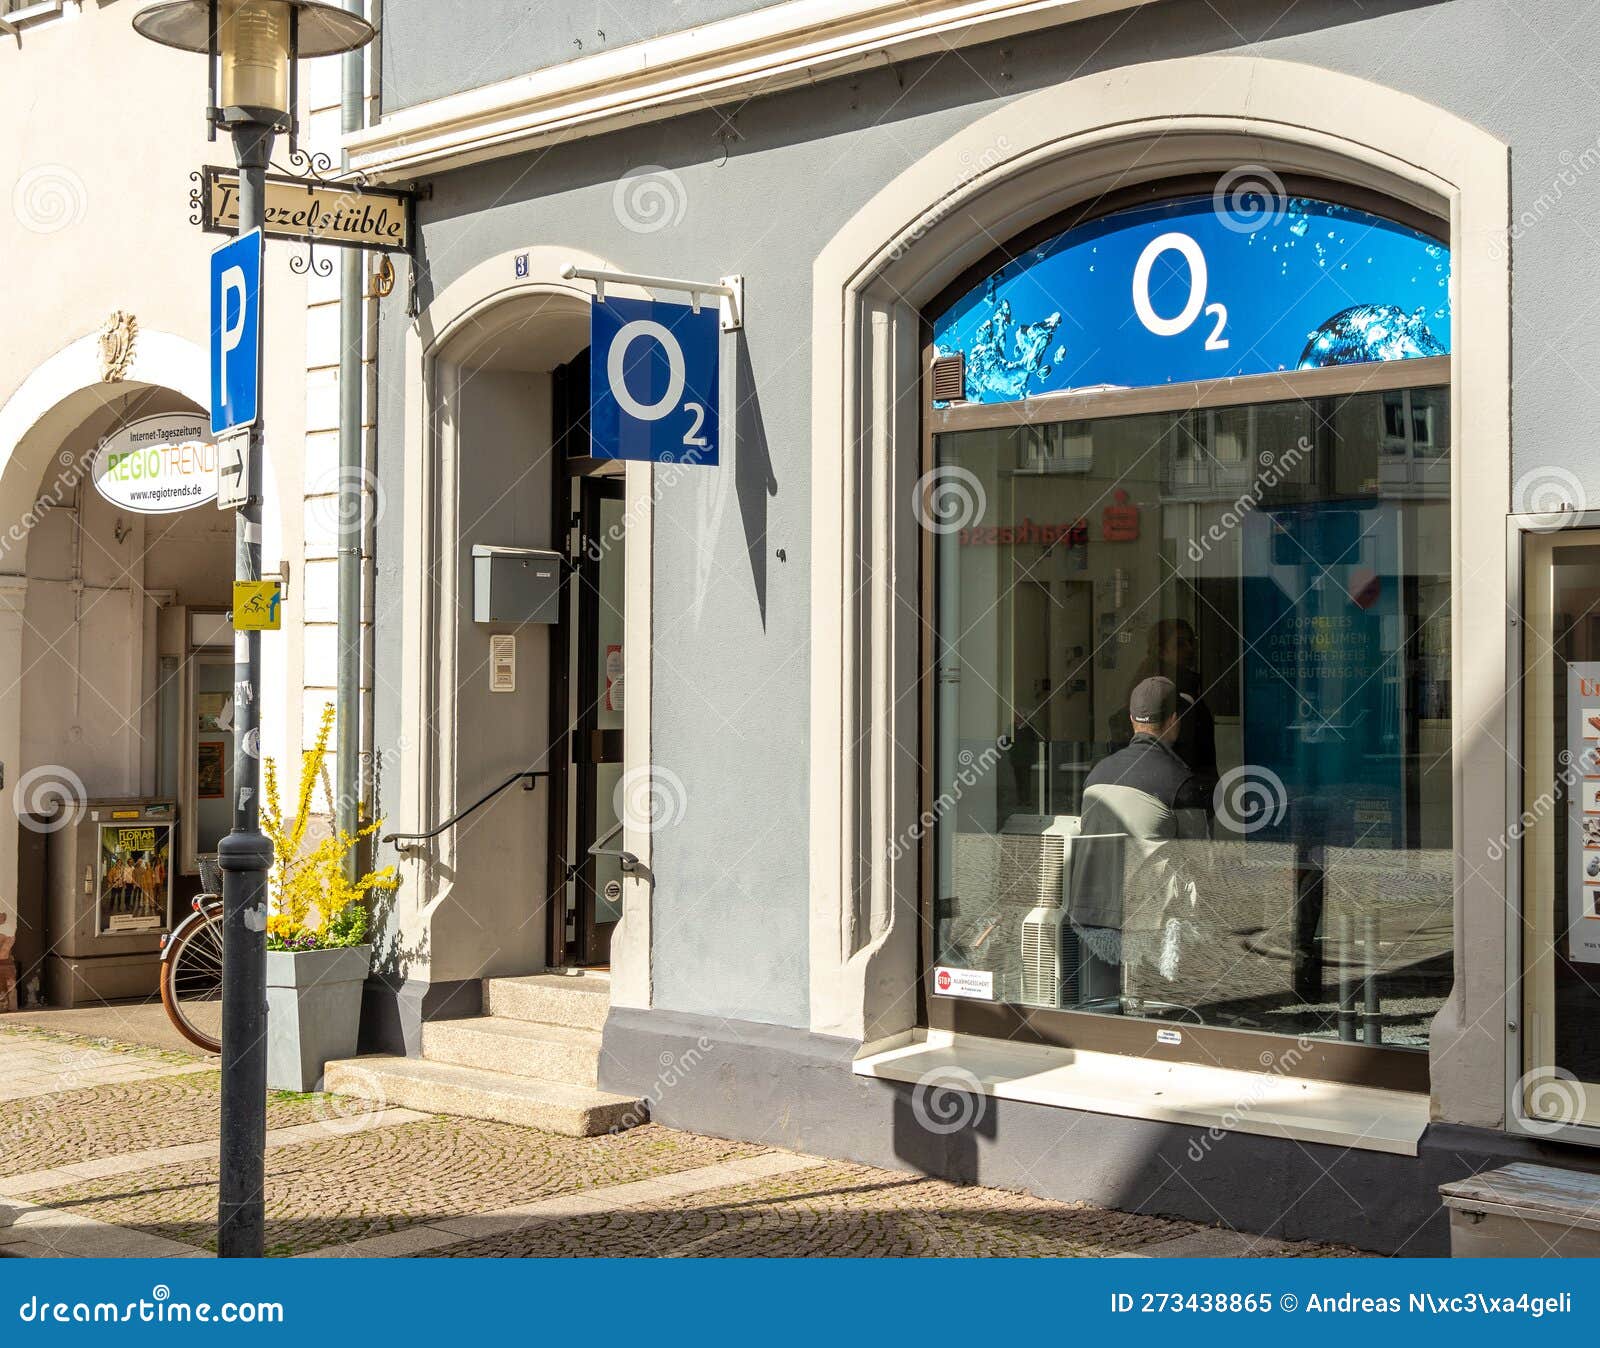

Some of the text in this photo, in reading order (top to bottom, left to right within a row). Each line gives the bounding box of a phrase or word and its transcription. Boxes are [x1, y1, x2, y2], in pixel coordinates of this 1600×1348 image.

[517, 256, 526, 275] 3
[221, 265, 247, 406] P
[129, 425, 202, 442] Internet-Tageszeitung
[107, 443, 219, 482] REGIOTREND
[129, 484, 202, 501] www.regiotrends.de
[119, 828, 155, 841] FLORIAN
[119, 839, 155, 851] PAUL
[938, 976, 951, 985] STOP
